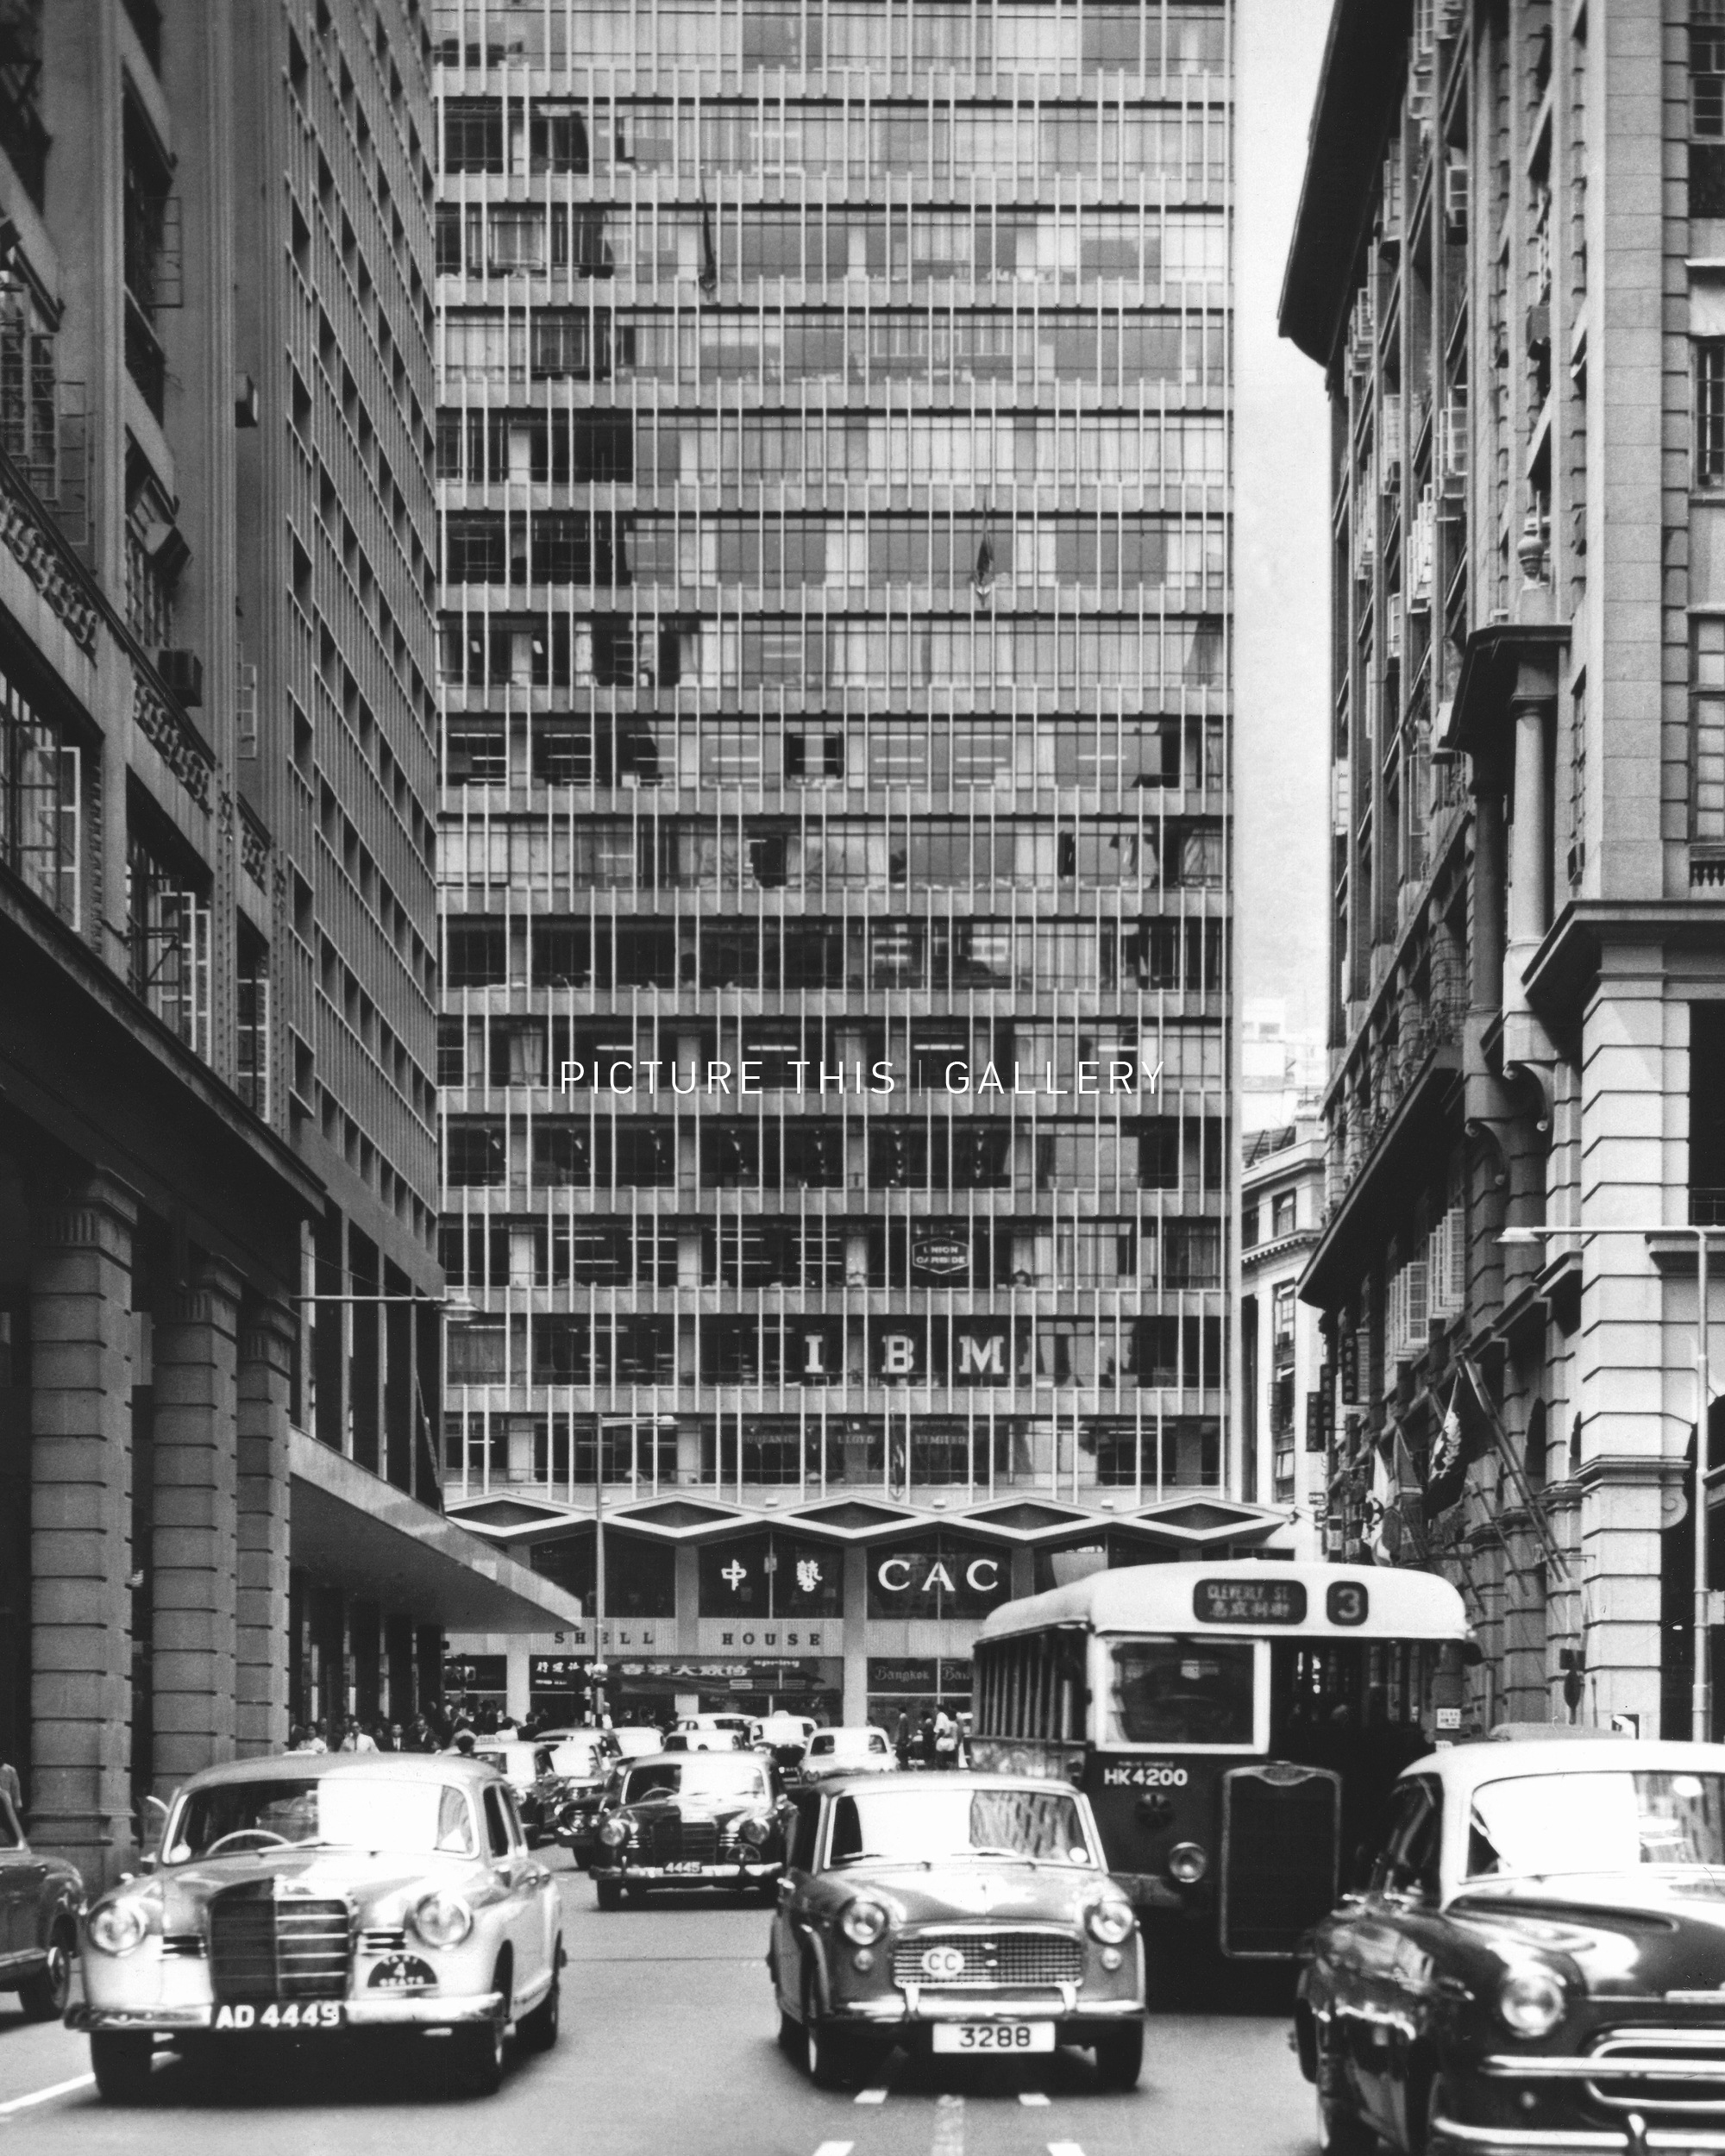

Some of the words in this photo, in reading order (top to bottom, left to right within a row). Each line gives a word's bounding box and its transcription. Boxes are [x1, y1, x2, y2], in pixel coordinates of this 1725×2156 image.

[805, 1335, 1005, 1375] IBM
[878, 1558, 999, 1592] CAC
[1338, 1589, 1360, 1619] 3
[554, 1632, 655, 1645] SHELL
[721, 1633, 821, 1646] HOUSE
[942, 1665, 971, 1682] Ban
[1104, 1768, 1189, 1786] HK4200
[393, 1962, 406, 1977] 4
[928, 1952, 957, 1971] CC
[215, 2004, 255, 2029] AD
[260, 2000, 341, 2028] 4449
[959, 2027, 1031, 2048] 3288
